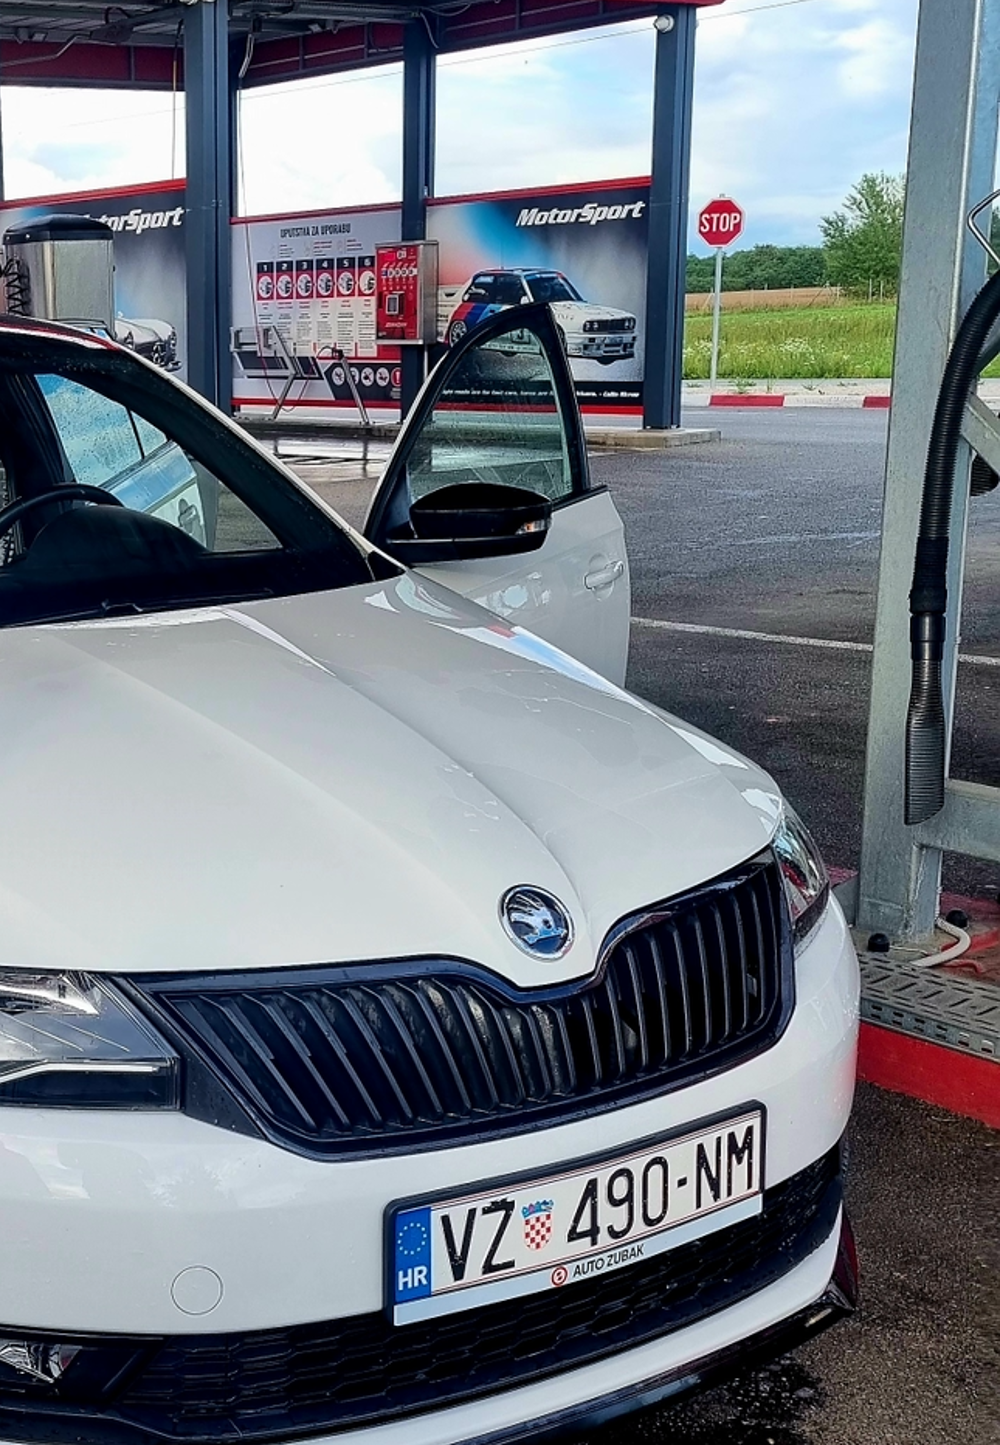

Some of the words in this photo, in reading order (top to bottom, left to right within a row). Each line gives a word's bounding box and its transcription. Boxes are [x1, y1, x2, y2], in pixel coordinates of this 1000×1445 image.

[96, 207, 185, 234] orSport
[515, 200, 646, 227] MotorSport
[700, 212, 741, 232] STOP
[262, 264, 268, 272] 1
[281, 263, 287, 271] 2
[322, 260, 328, 268] 4
[343, 259, 348, 267] 5
[364, 257, 370, 266] 6
[441, 1198, 516, 1282] VŽ
[567, 1125, 754, 1247] 490-NM
[573, 1258, 605, 1278] AUTO
[607, 1243, 645, 1267] ZUBAK
[398, 1266, 428, 1291] HR
